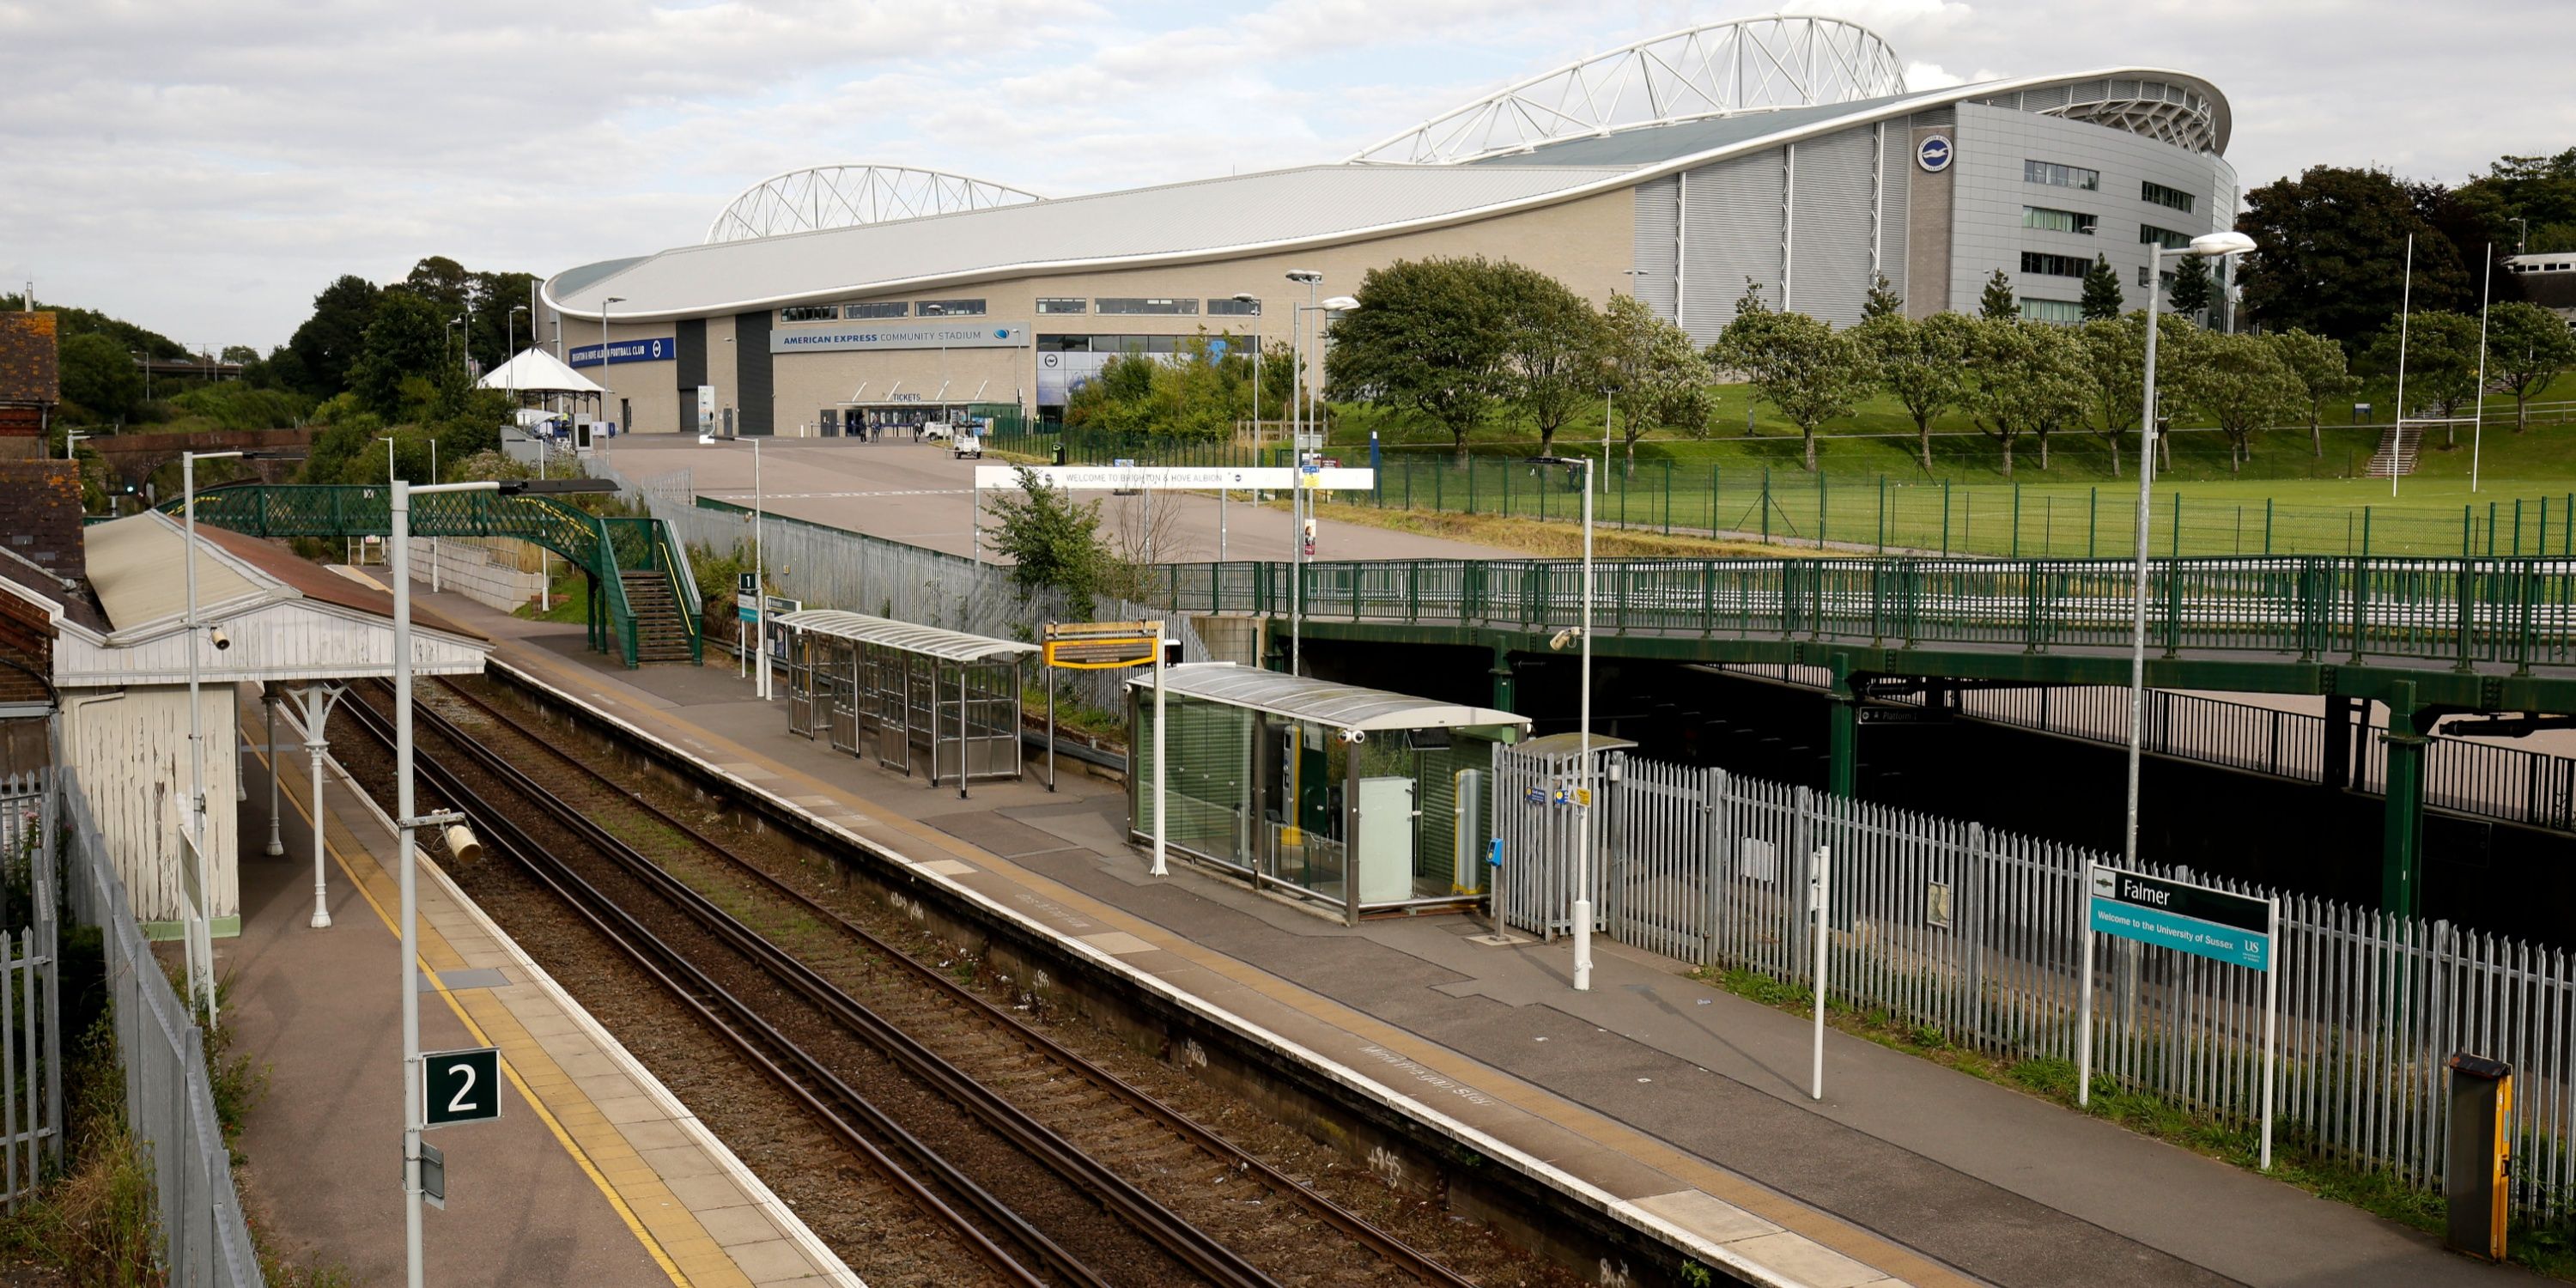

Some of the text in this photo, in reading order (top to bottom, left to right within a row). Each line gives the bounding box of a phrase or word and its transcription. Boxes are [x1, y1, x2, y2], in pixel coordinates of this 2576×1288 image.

[784, 331, 981, 344] AMERICAN EXPRESS COMMUNITY STADIUM
[597, 349, 611, 359] ALBN
[611, 346, 631, 357] FOOTBALL
[632, 345, 645, 355] CLUB
[893, 393, 920, 402] TICKETS
[1066, 474, 1106, 483] WELCOME
[1109, 474, 1117, 483] TO
[1121, 474, 1161, 483] BRIGHTON
[1171, 474, 1192, 483] HOVE
[1194, 474, 1223, 483] ALBION
[746, 574, 751, 587] 1
[2124, 878, 2171, 906] Falmer
[2098, 910, 2234, 950] Welcome to the University of Sussex
[2245, 939, 2259, 953] US
[448, 1063, 477, 1113] 2
